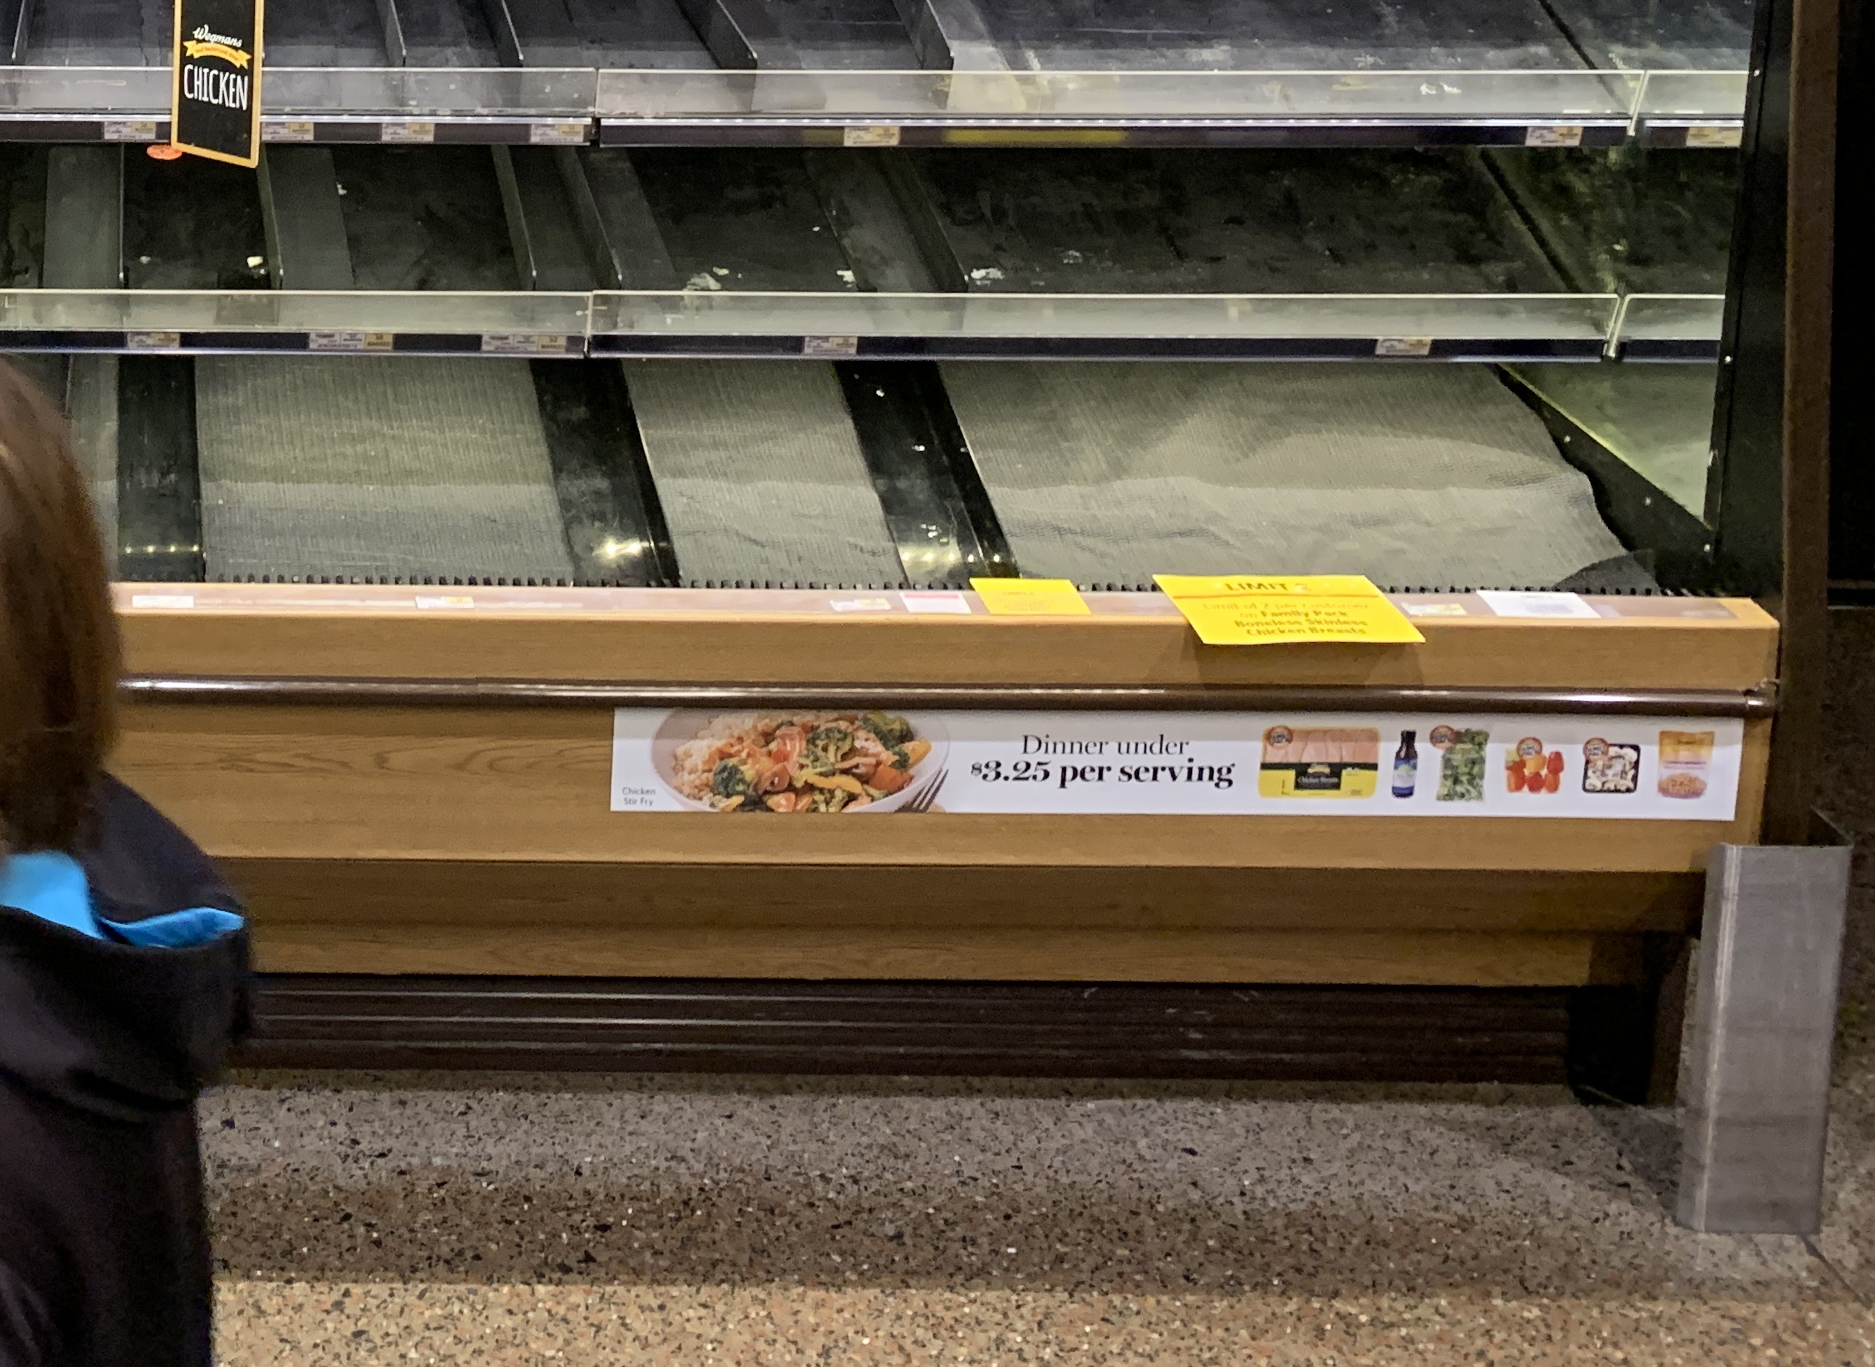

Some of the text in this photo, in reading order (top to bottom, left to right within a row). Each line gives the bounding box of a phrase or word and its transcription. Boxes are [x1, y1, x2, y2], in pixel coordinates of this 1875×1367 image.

[192, 23, 243, 48] Wegmans
[183, 63, 249, 111] CHICKEN
[1225, 582, 1289, 592] LIMIT
[1021, 733, 1190, 755] Dinner under
[970, 756, 1236, 790] $3.25 per serving
[621, 786, 657, 796] Chicken
[640, 796, 654, 807] Fry
